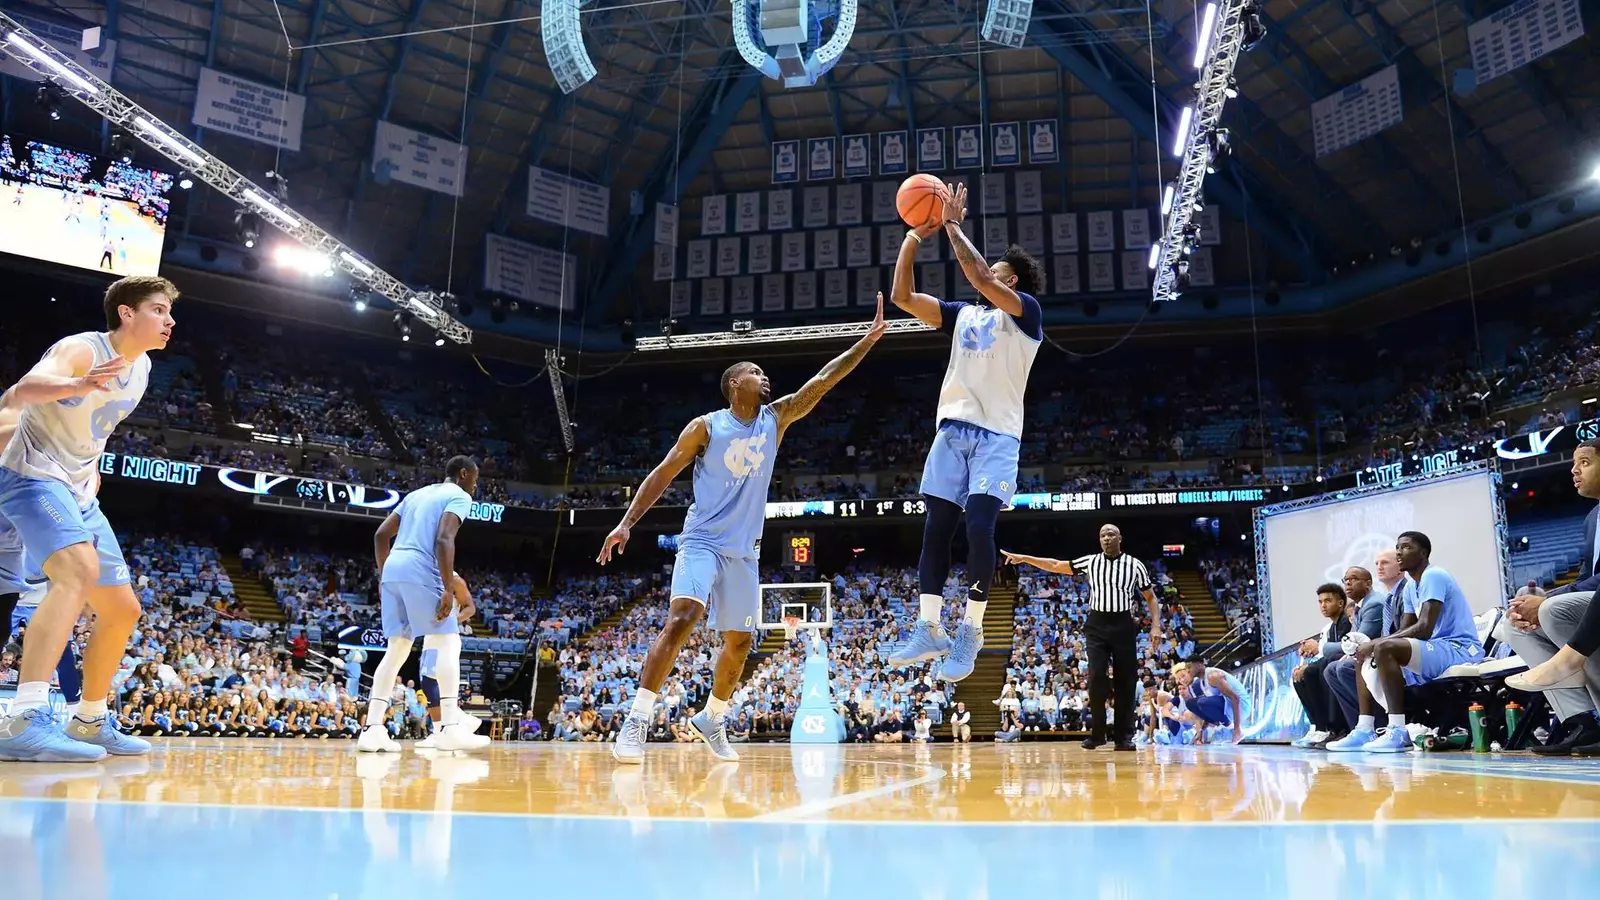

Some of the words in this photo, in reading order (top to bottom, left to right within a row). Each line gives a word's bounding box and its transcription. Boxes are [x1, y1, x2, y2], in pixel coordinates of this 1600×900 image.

[121, 455, 202, 485] NIGHT
[979, 477, 988, 490] 2
[1111, 494, 1126, 506] FOR
[1126, 493, 1156, 506] TICKETS
[1157, 492, 1177, 505] VISIT
[1178, 489, 1264, 503] GOHEELS.COM/TICKETS
[467, 501, 505, 523] ROY
[839, 502, 858, 517] 11
[792, 538, 810, 547] 8:29
[794, 548, 808, 562] 13
[745, 616, 752, 627] 0
